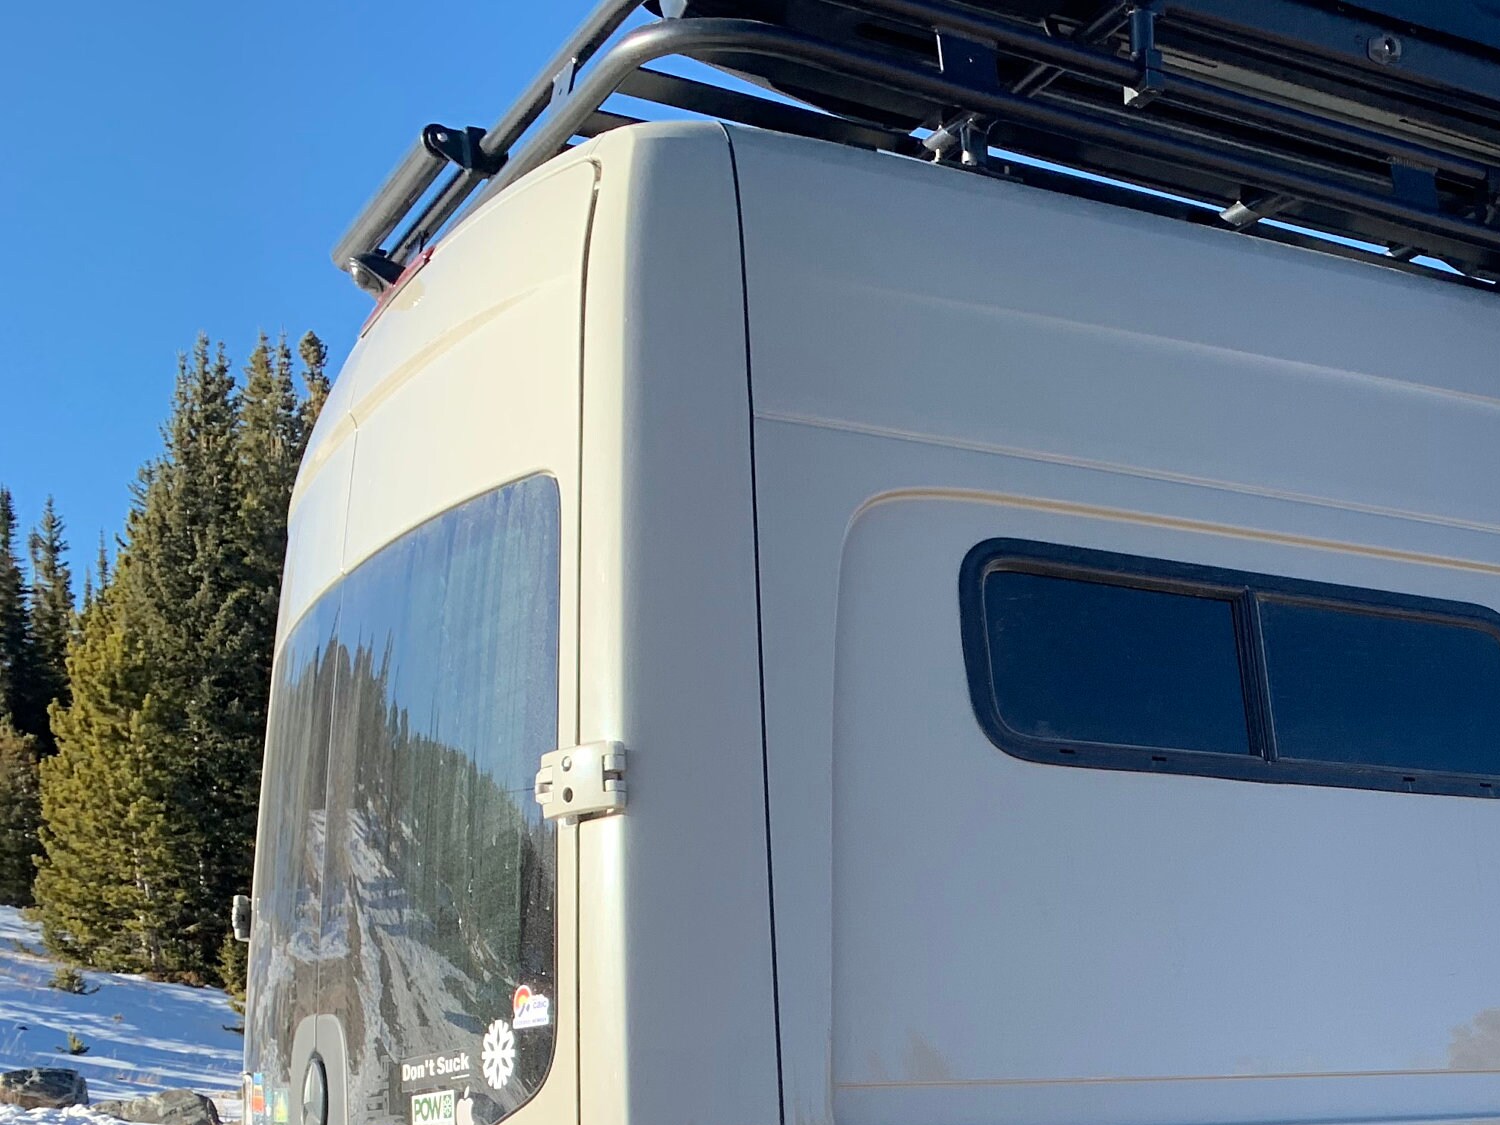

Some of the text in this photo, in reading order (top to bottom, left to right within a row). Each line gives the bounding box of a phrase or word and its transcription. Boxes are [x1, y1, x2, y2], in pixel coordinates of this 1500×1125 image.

[402, 1052, 470, 1081] Don't Suck
[413, 1095, 442, 1122] POW
